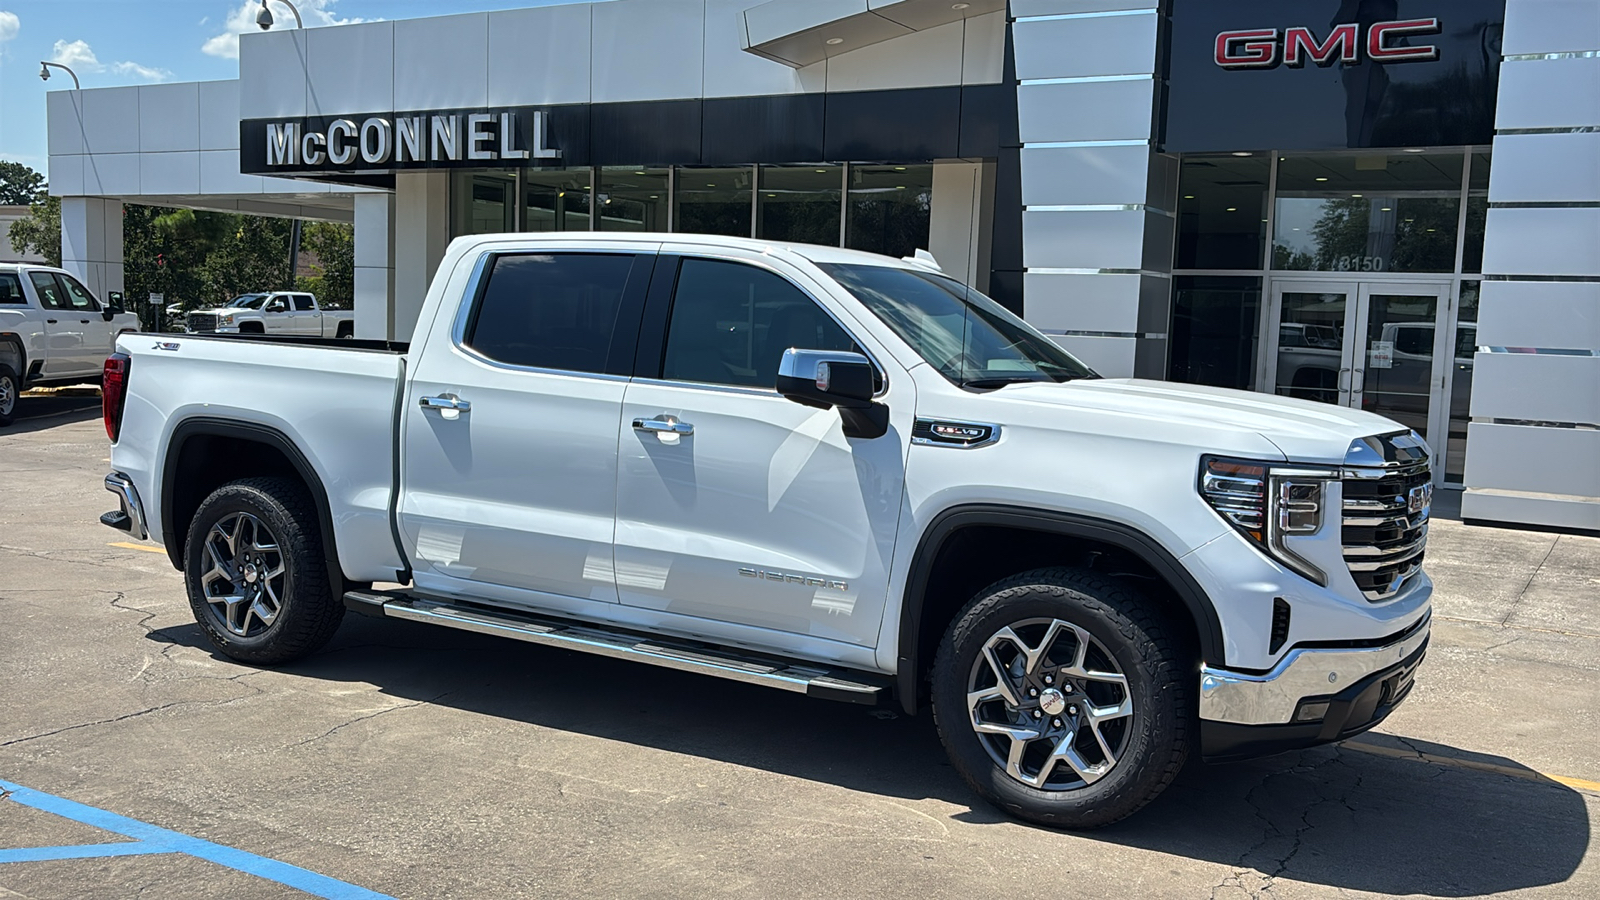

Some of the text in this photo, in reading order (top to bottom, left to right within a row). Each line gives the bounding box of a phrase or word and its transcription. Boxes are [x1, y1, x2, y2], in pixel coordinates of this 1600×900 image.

[1214, 17, 1439, 66] GMC
[266, 110, 562, 166] McCONNELL
[738, 567, 849, 591] SIERRA
